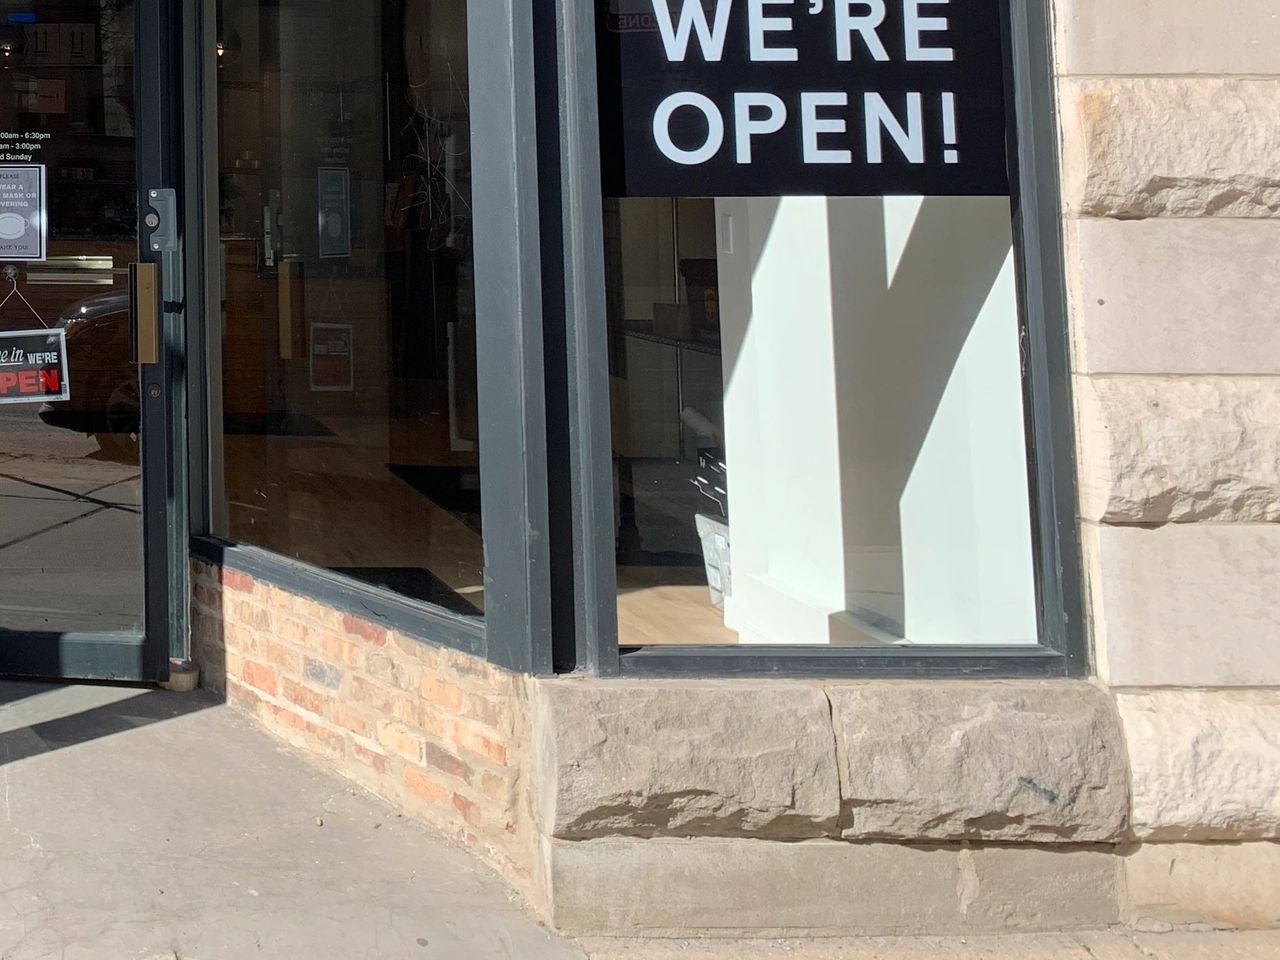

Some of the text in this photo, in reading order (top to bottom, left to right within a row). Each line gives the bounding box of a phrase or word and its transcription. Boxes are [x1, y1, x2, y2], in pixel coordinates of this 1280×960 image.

[652, 91, 961, 165] OPEN!
[24, 131, 50, 140] 6:30pm
[15, 142, 41, 151] 3:00pm
[5, 153, 33, 162] Sunday
[10, 346, 24, 362] in
[27, 351, 58, 365] WE'RE
